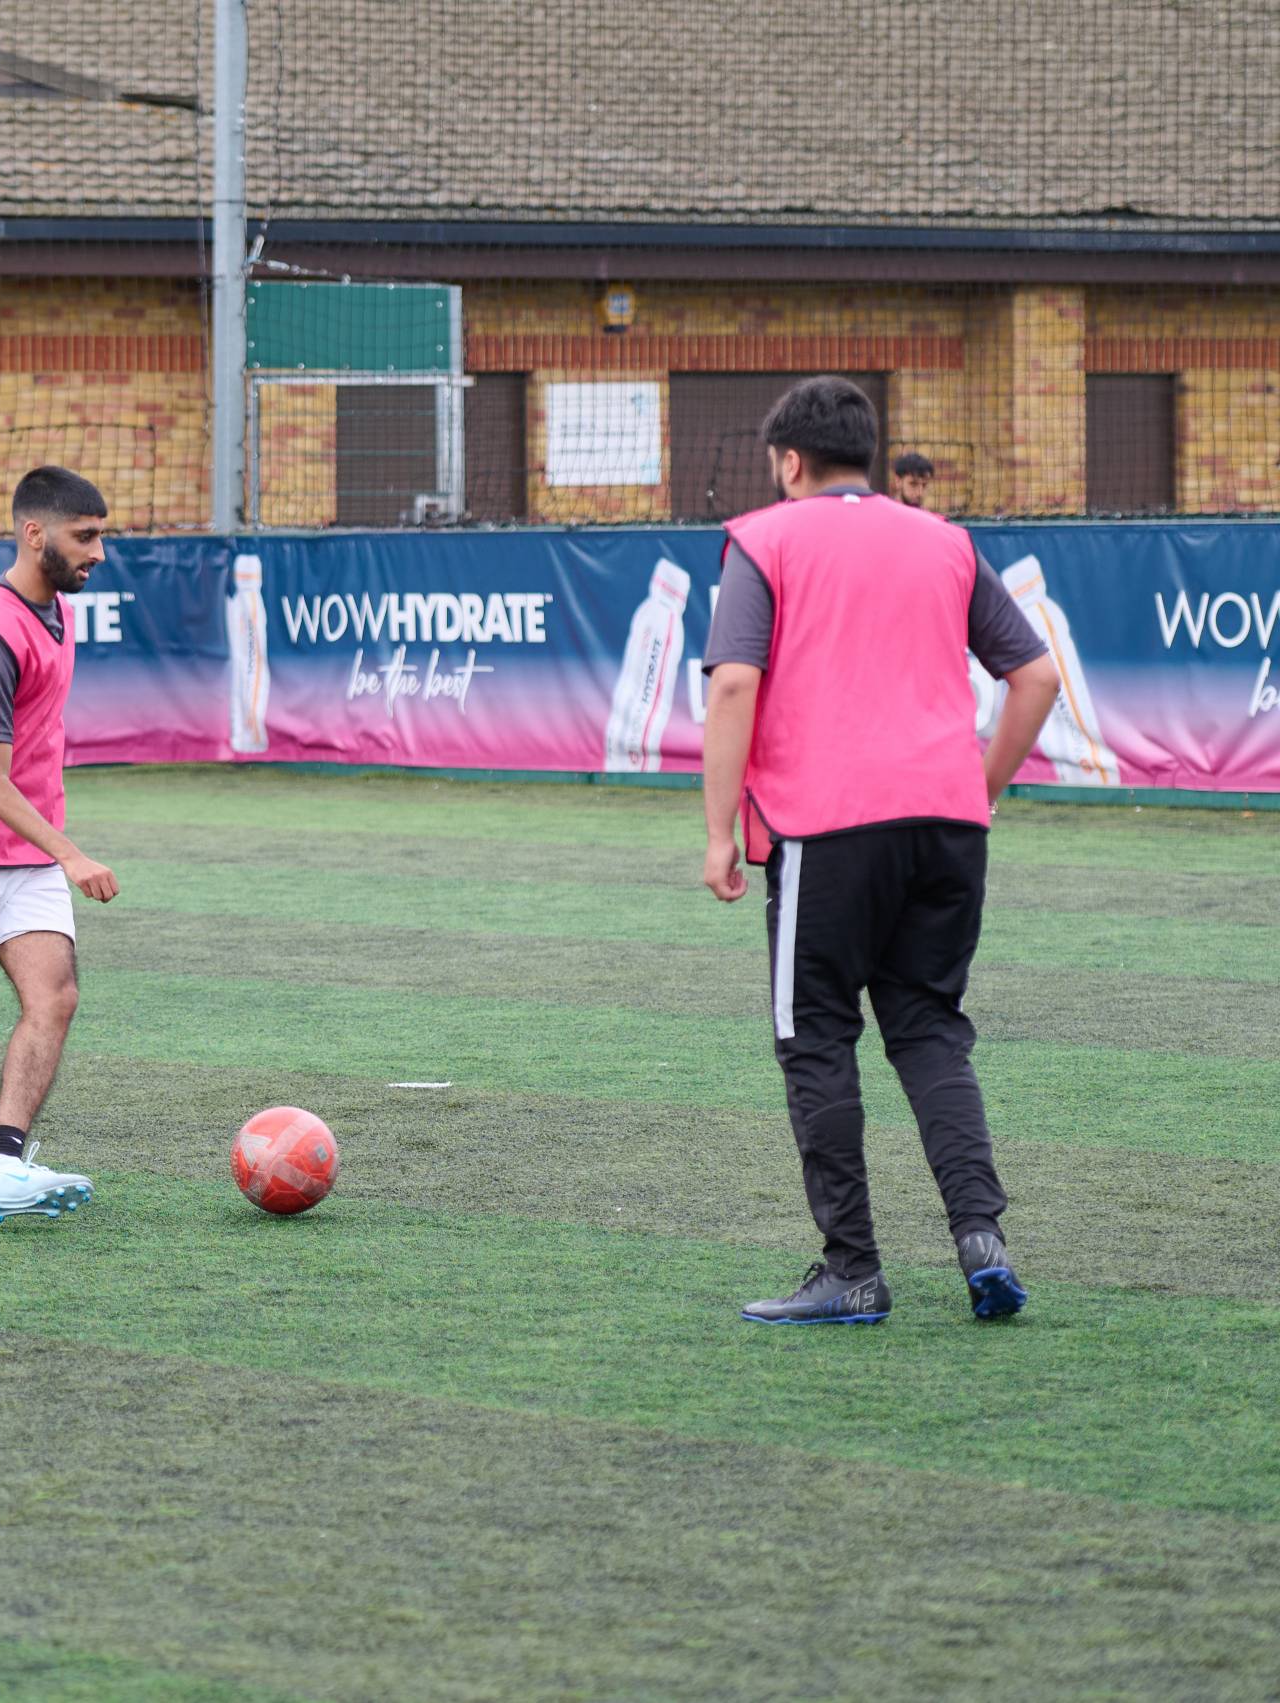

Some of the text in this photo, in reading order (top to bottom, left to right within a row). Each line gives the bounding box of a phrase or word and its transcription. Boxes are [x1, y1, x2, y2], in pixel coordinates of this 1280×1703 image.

[281, 592, 546, 644] WOWHYDRATE
[346, 644, 495, 719] be the best
